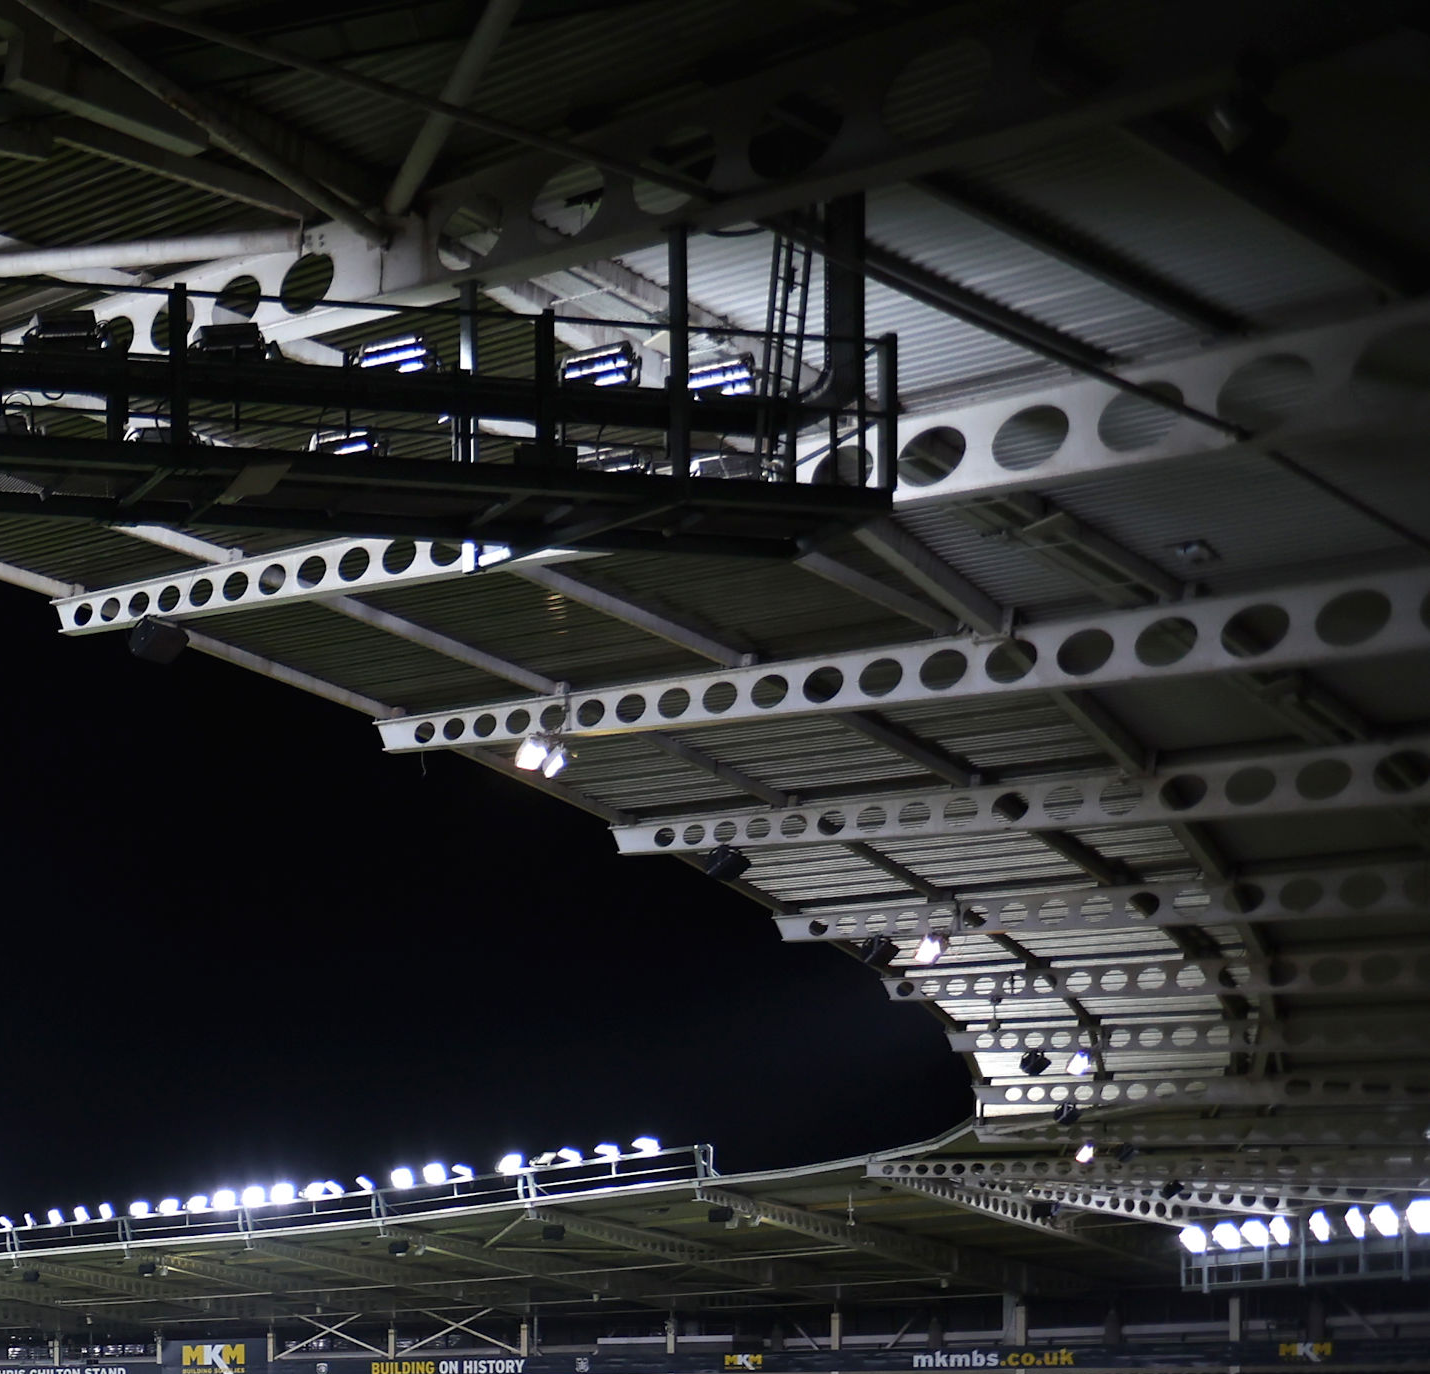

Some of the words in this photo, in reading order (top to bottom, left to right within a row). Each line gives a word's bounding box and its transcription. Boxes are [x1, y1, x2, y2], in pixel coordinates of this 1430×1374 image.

[182, 1344, 245, 1374] MKM
[724, 1353, 763, 1370] MKM
[913, 1348, 1075, 1369] mkmbs.co.uk
[1279, 1342, 1332, 1362] MKM
[439, 1360, 459, 1374] ON
[463, 1359, 525, 1374] HISTORY
